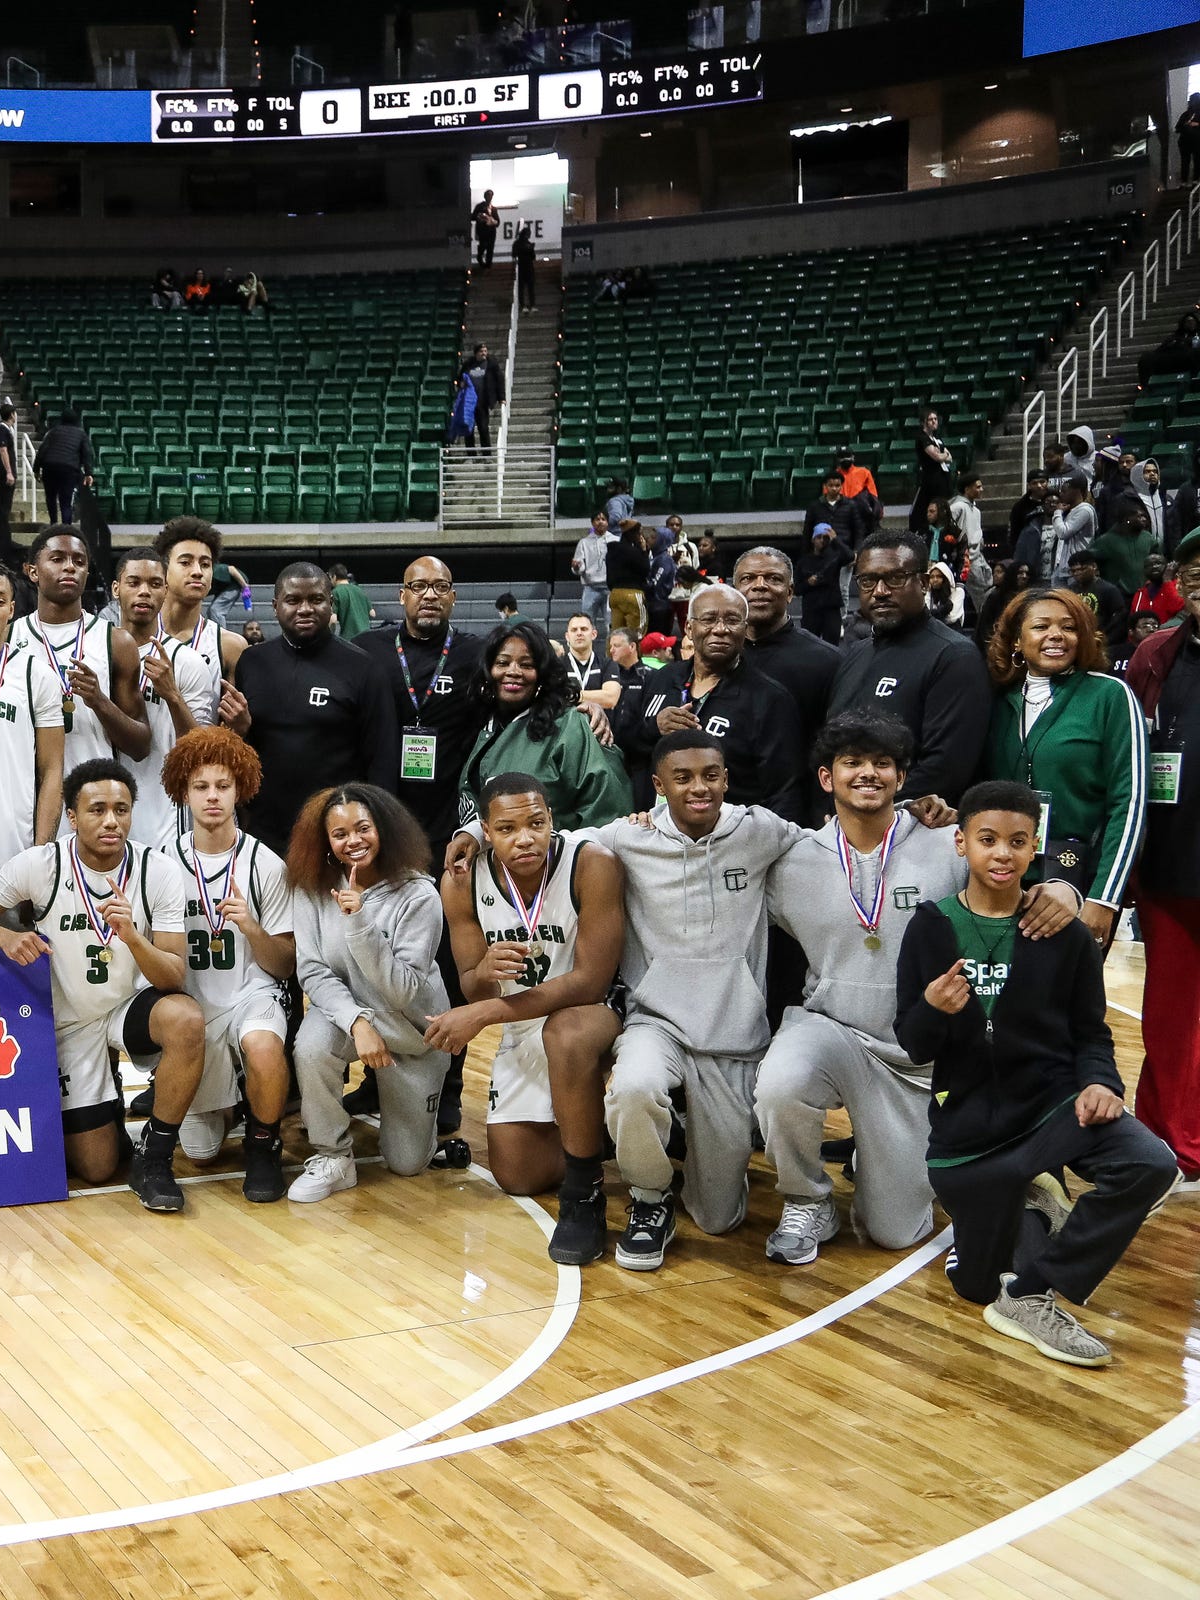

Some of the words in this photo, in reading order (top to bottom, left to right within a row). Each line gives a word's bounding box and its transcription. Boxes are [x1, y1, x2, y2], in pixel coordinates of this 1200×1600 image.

[609, 70, 643, 86] FG%
[654, 65, 689, 82] FT%
[700, 61, 709, 76] F
[165, 99, 197, 113] FG%
[207, 99, 238, 113] FT%
[248, 98, 257, 111] F
[266, 97, 294, 111] TOL
[374, 92, 411, 109] BEE
[494, 84, 519, 102] SF
[564, 83, 581, 108] 0
[616, 92, 638, 106] 0.0
[659, 88, 682, 101] 0.0
[322, 100, 339, 124] 0
[434, 114, 467, 126] FIRST
[171, 120, 193, 133] 0.0
[214, 119, 235, 132] 0.0
[1110, 183, 1134, 195] 106
[574, 247, 591, 257] 104
[531, 924, 566, 944] EH
[188, 929, 236, 970] 30
[86, 944, 108, 984] 3
[963, 958, 1012, 985] Spa
[972, 982, 1005, 996] ealt
